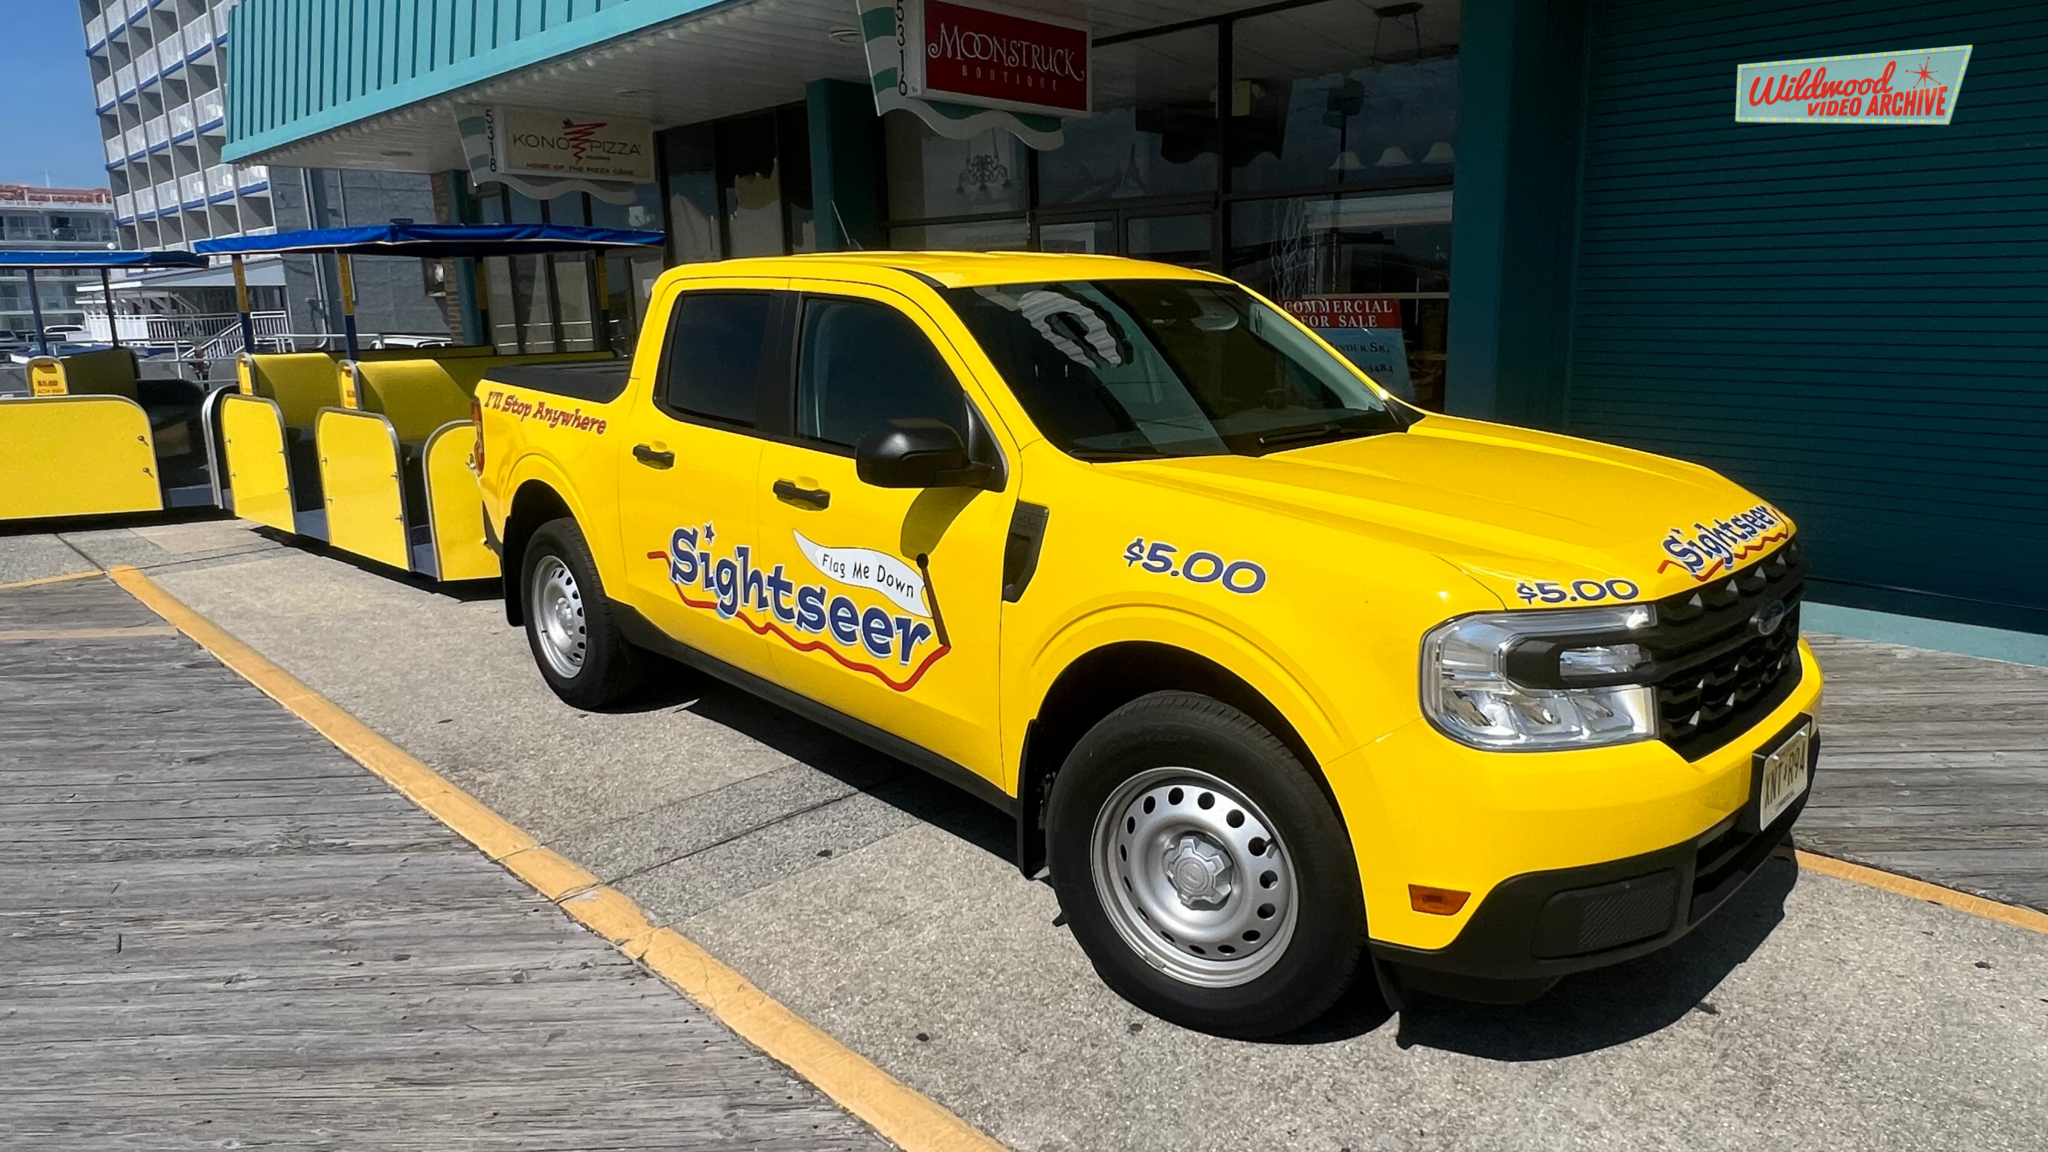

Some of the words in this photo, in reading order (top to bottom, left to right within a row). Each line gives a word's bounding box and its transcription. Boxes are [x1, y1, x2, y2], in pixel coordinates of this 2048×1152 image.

[928, 23, 1085, 82] MOONSTRUCK
[962, 64, 1057, 92] BOUTIQUE
[485, 109, 498, 173] 5318
[513, 133, 570, 151] KONO
[590, 139, 642, 157] PIZZA
[526, 162, 551, 170] HOME
[586, 166, 610, 174] PIZZA
[1284, 300, 1393, 314] COMMERCIAL
[1300, 315, 1330, 328] FOR
[1339, 315, 1378, 328] SALE
[501, 394, 533, 422] Stop
[532, 401, 607, 435] Anywhere
[1661, 504, 1779, 577] Sightseer
[821, 554, 847, 578] Flag
[852, 561, 870, 580] Me
[877, 564, 914, 599] Down
[1123, 538, 1266, 594] $5.00
[669, 521, 933, 665] Sightseer
[1516, 579, 1639, 606] $5.00
